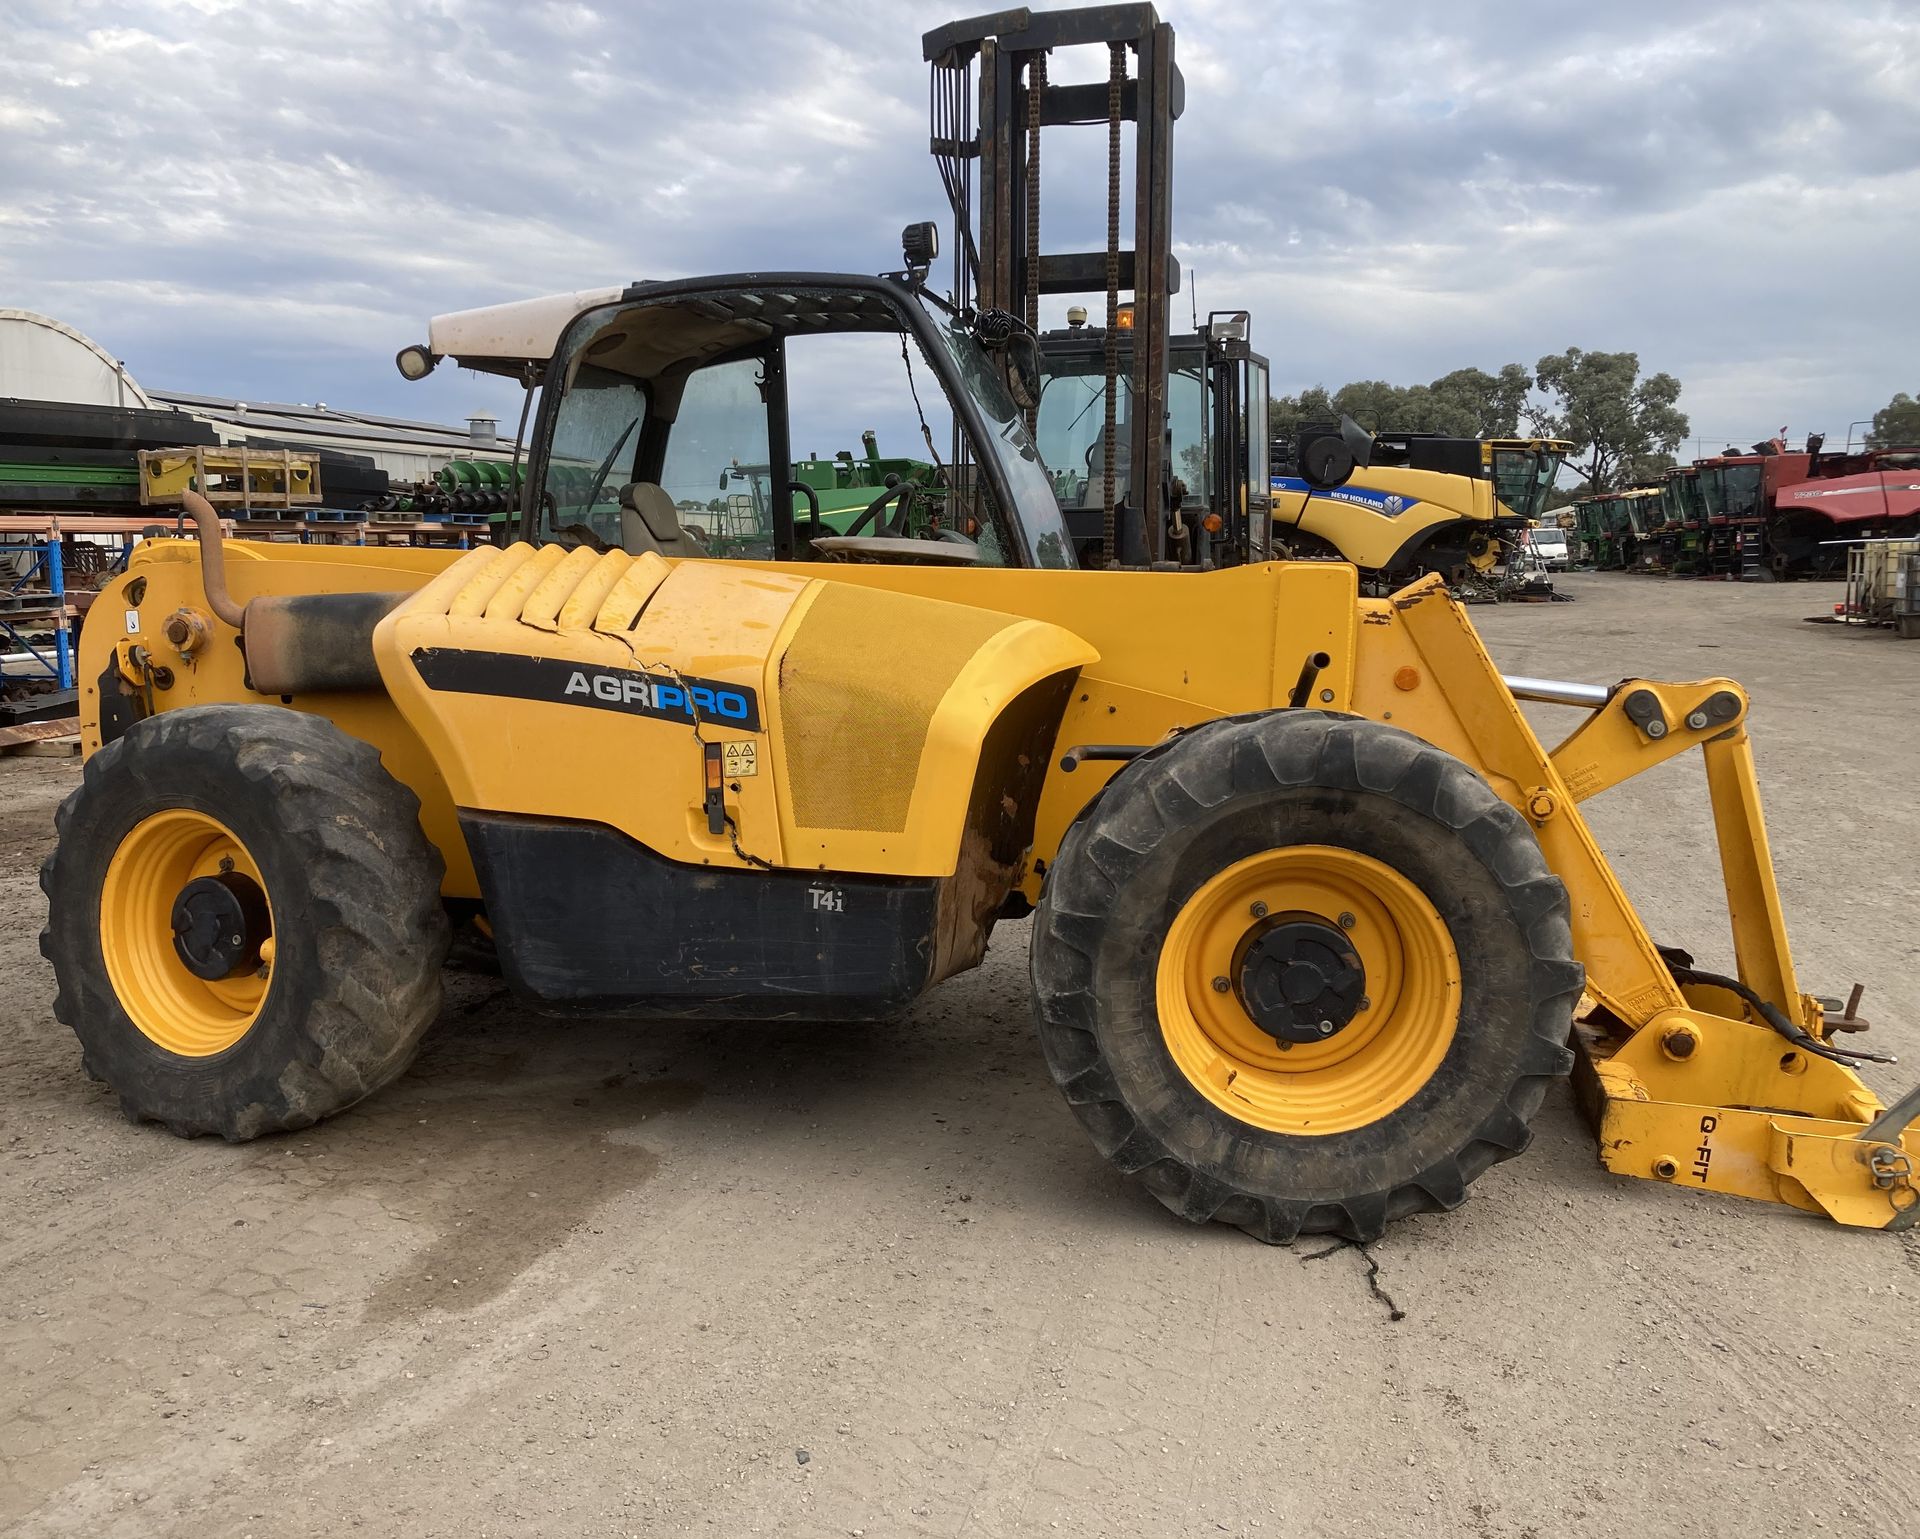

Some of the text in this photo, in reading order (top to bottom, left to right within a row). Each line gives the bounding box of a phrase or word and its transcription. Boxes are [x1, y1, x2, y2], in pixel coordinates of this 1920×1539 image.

[1331, 491, 1383, 508] NEW HOLLAND
[564, 671, 748, 719] AGRIPRO
[808, 888, 844, 912] T4i
[1692, 1115, 1717, 1183] Q-FIT
